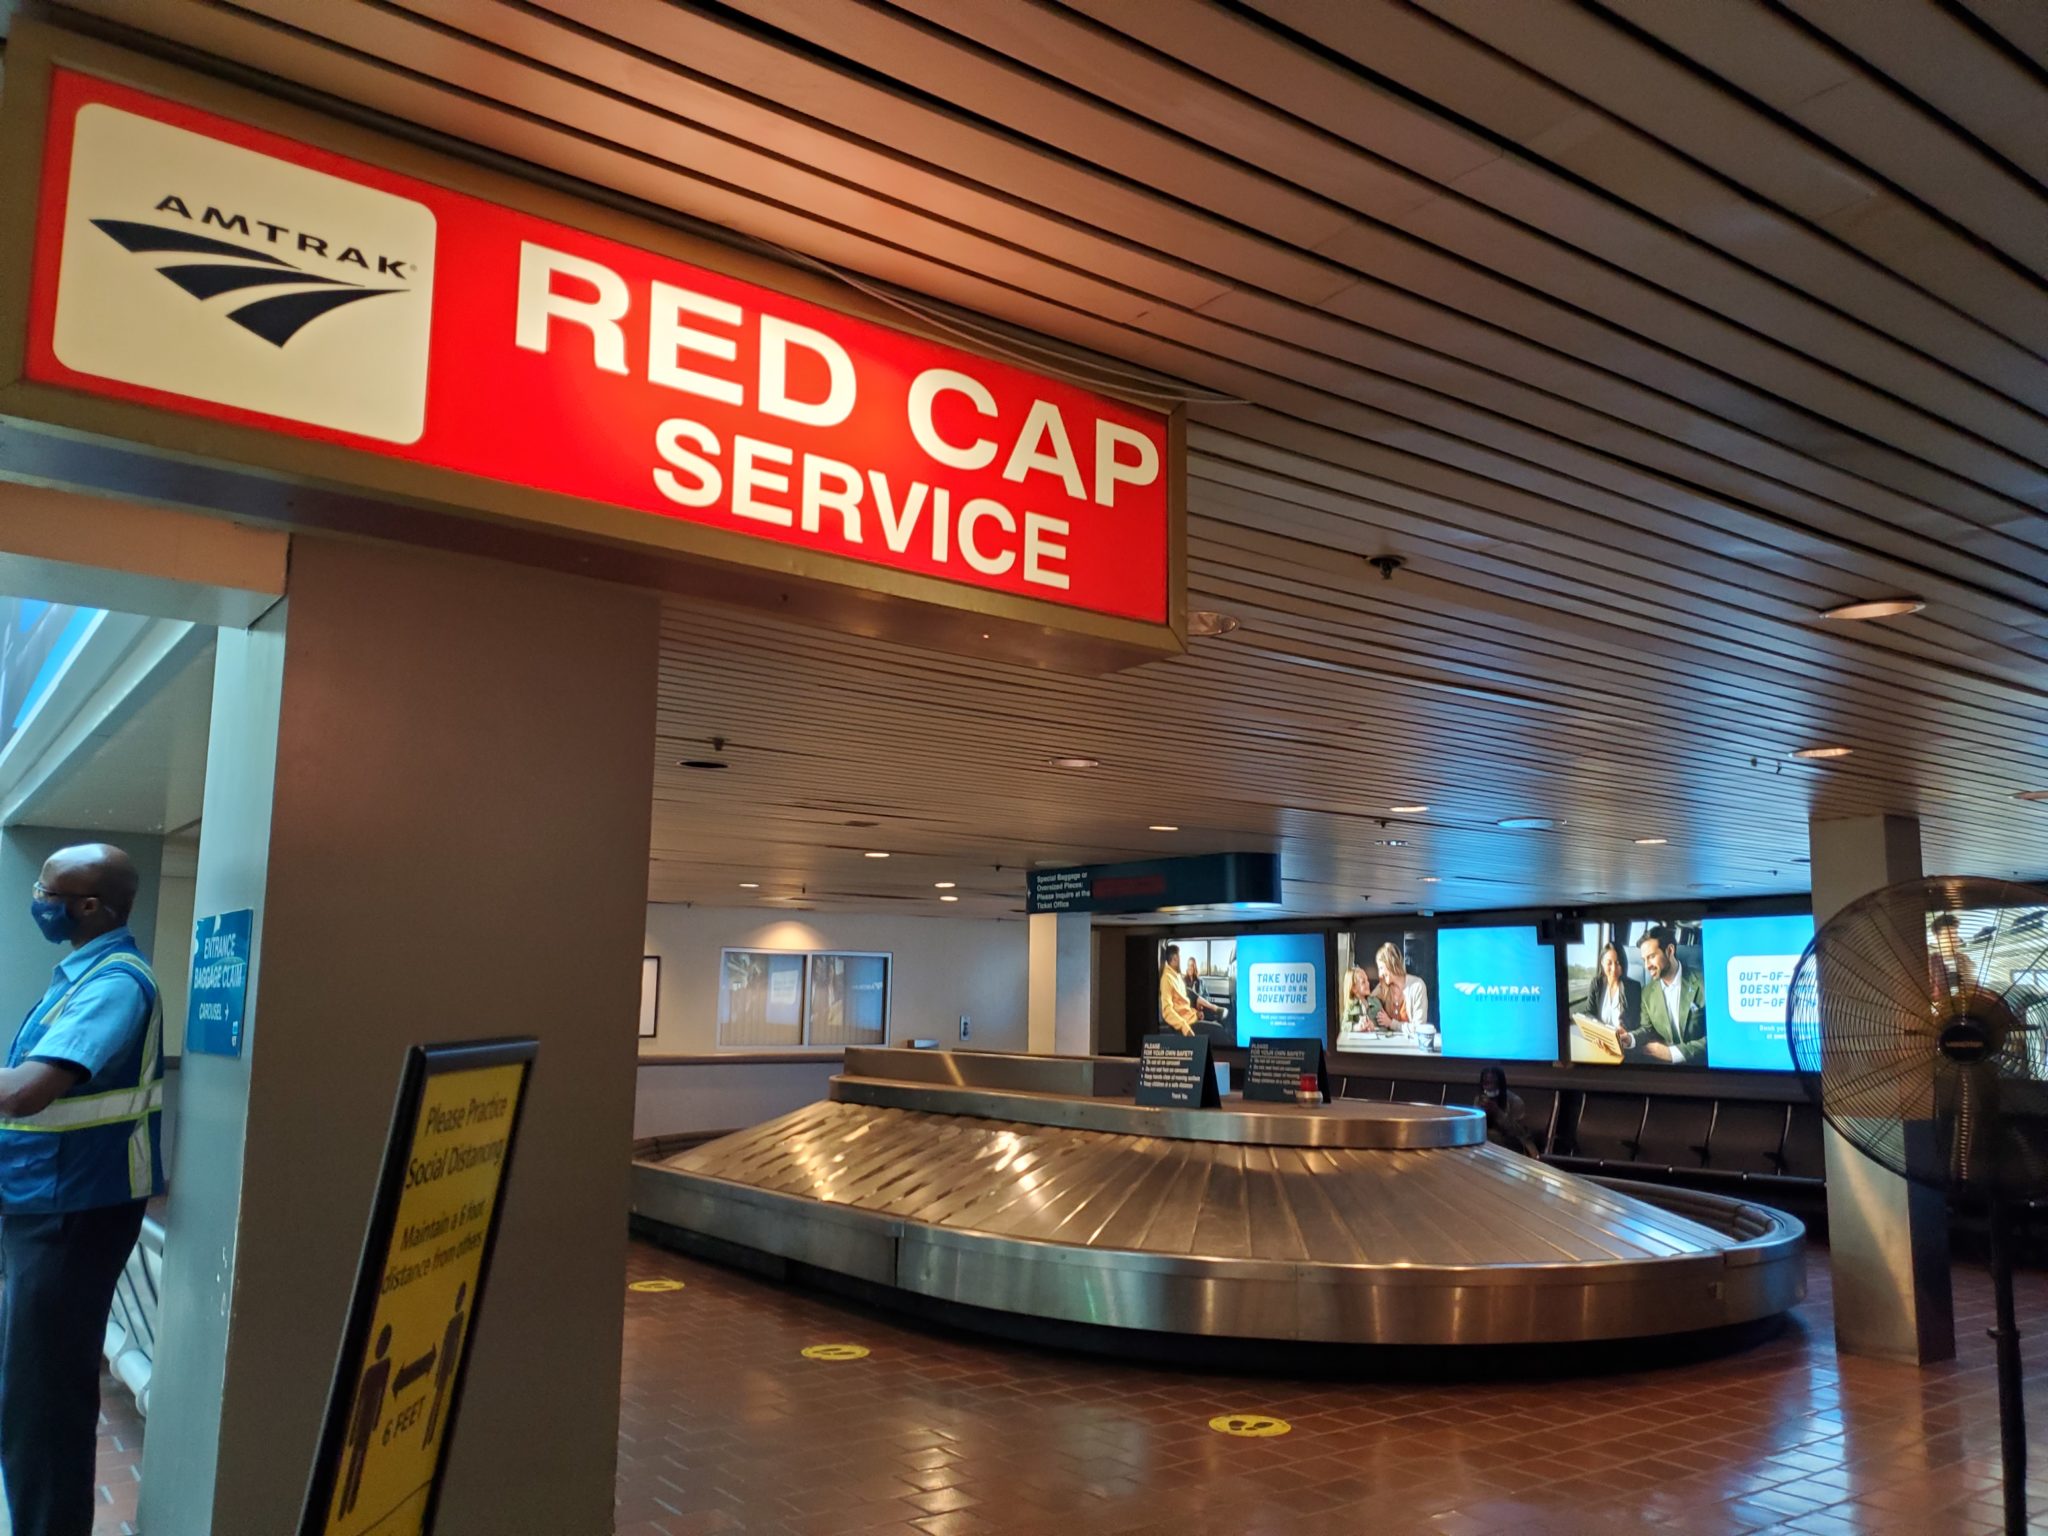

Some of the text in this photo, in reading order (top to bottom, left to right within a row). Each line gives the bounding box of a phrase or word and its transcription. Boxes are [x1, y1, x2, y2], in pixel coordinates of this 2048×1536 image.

[154, 194, 407, 280] AMTRAK
[514, 239, 1160, 509] RED CAP
[652, 417, 1070, 590] SERVICE
[1036, 901, 1070, 910] Ticket Office
[203, 933, 237, 960] ENTRANCE
[193, 963, 244, 990] BAGGAGE CLAIM
[1256, 972, 1309, 984] TAKE YOUR
[1288, 985, 1297, 993] ON
[1476, 985, 1541, 996] AMTRAK
[199, 1002, 222, 1020] CAROUSEL
[1256, 993, 1308, 1004] ADVENTURE
[424, 1092, 508, 1137] Please Practice
[405, 1138, 505, 1189] Social Distancing
[400, 1210, 451, 1252] Maintain
[380, 1258, 432, 1295] distance
[432, 1247, 457, 1270] from
[381, 1394, 427, 1448] 6 FEET
